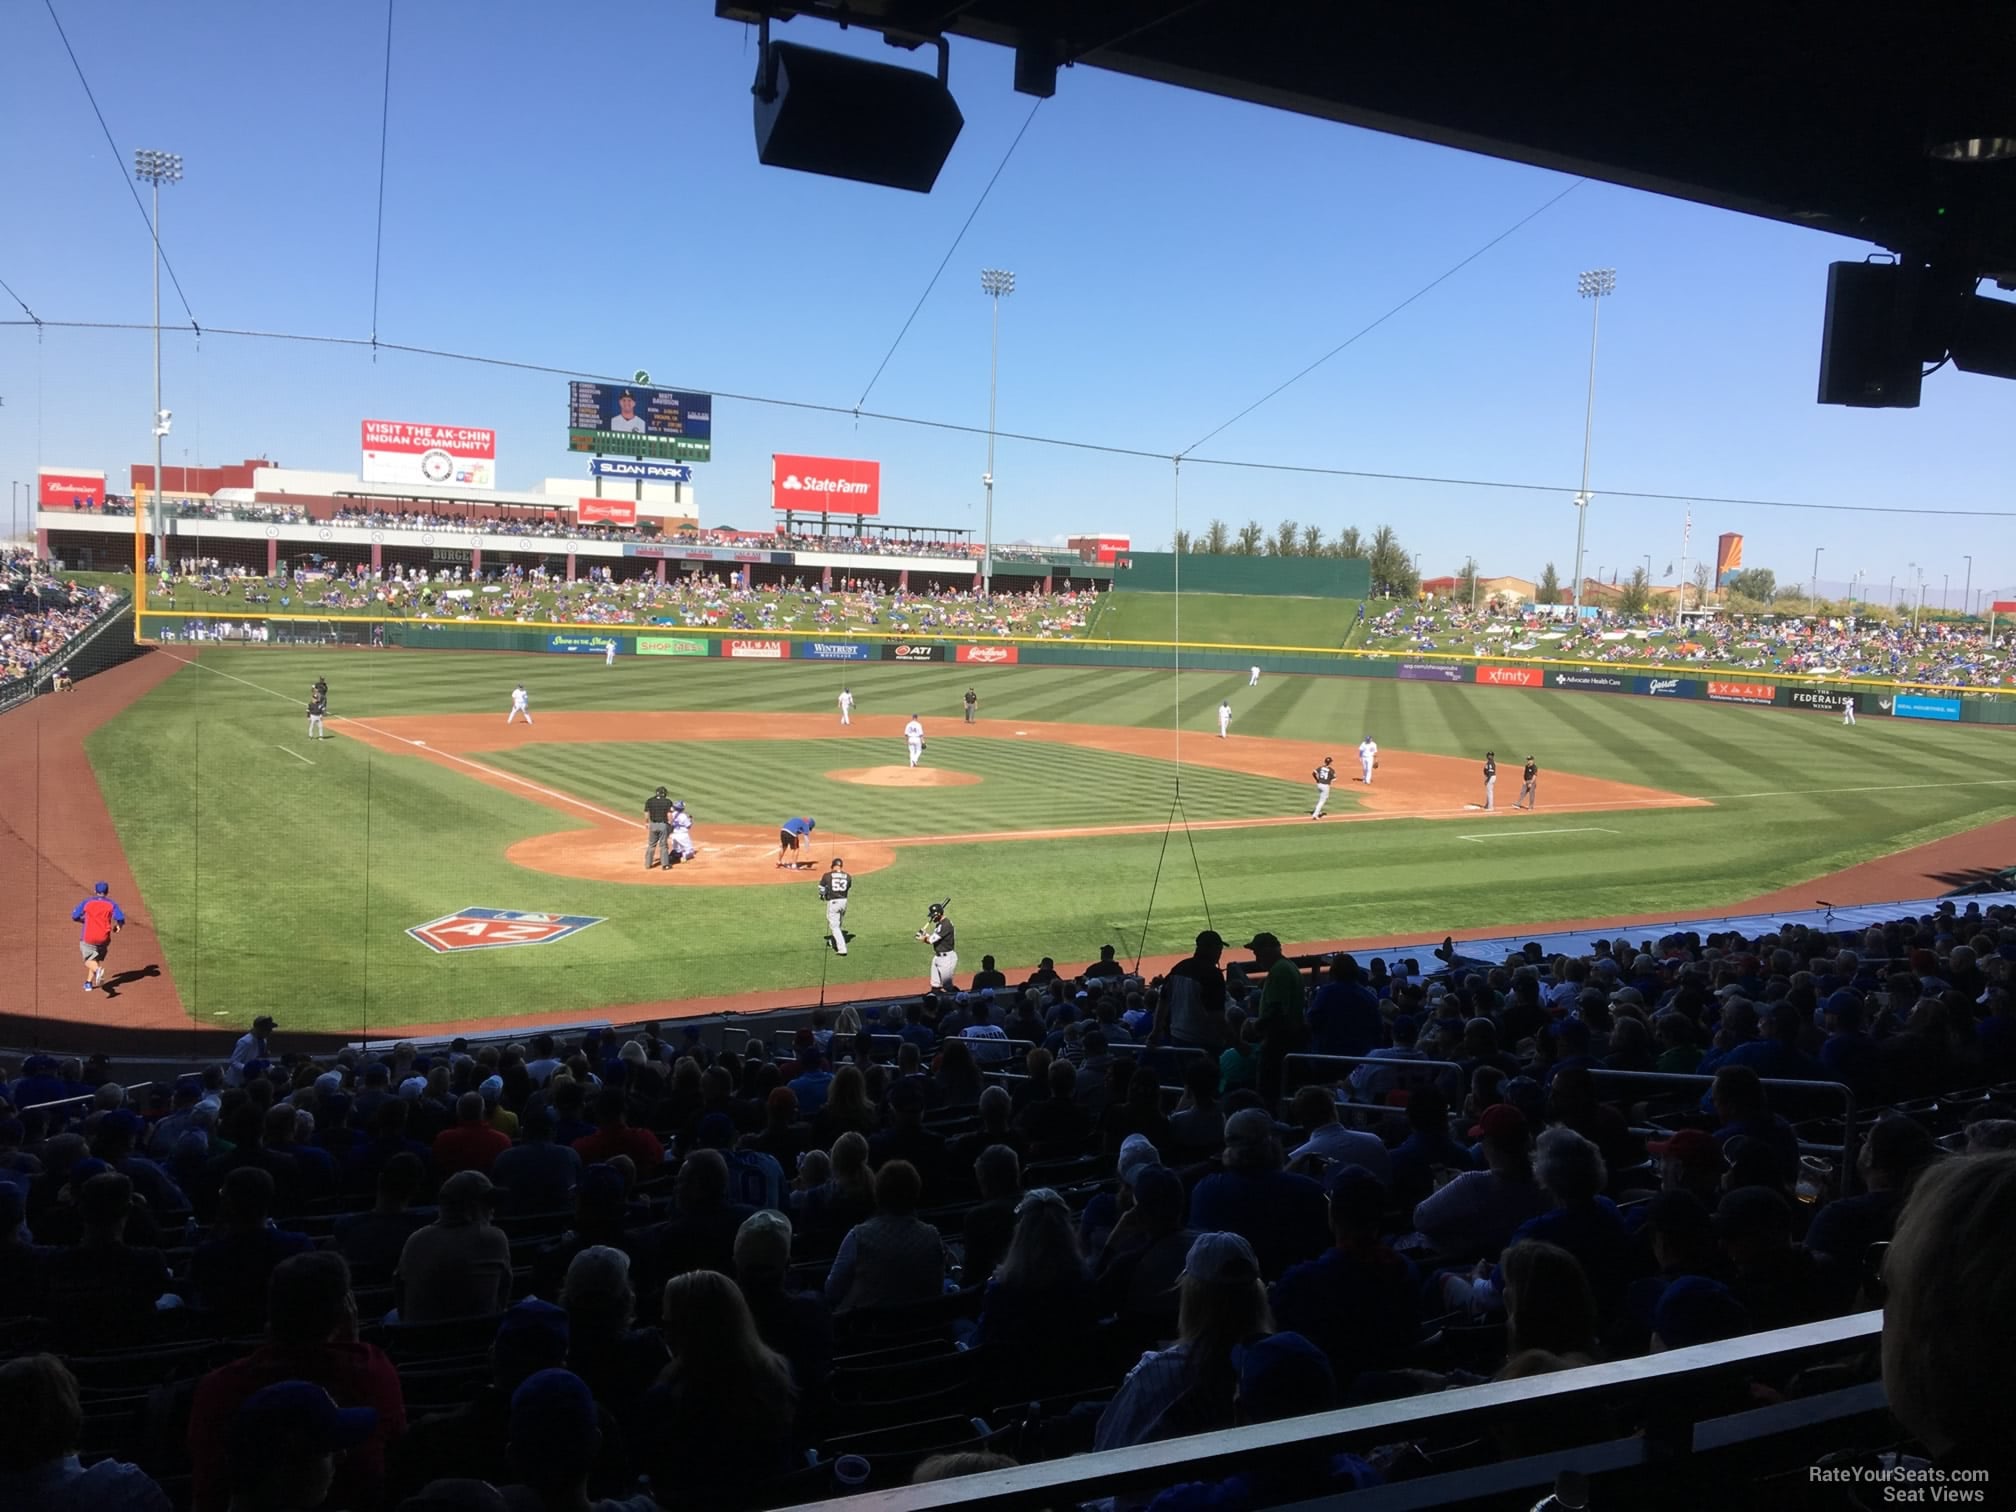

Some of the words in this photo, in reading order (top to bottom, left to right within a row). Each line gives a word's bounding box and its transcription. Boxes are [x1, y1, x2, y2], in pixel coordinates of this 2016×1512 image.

[366, 422, 402, 434] VISIT
[405, 426, 433, 438] THE
[436, 429, 490, 441] AK-CHIN
[366, 434, 410, 445] INDIAN
[413, 437, 490, 451] COMMUNITY
[600, 463, 644, 474] SLOAN
[648, 466, 682, 477] PARK
[433, 548, 472, 561] BURGE
[732, 640, 752, 649] CAL
[764, 641, 780, 649] AM
[814, 643, 858, 653] WINTRUST
[910, 646, 932, 655] ATI
[1489, 669, 1530, 685] xfinity
[1567, 676, 1590, 684] Advocate
[1590, 677, 1608, 685] Health
[1793, 692, 1851, 705] FEDERALIS
[831, 878, 848, 891] 53
[433, 922, 550, 939] AZ
